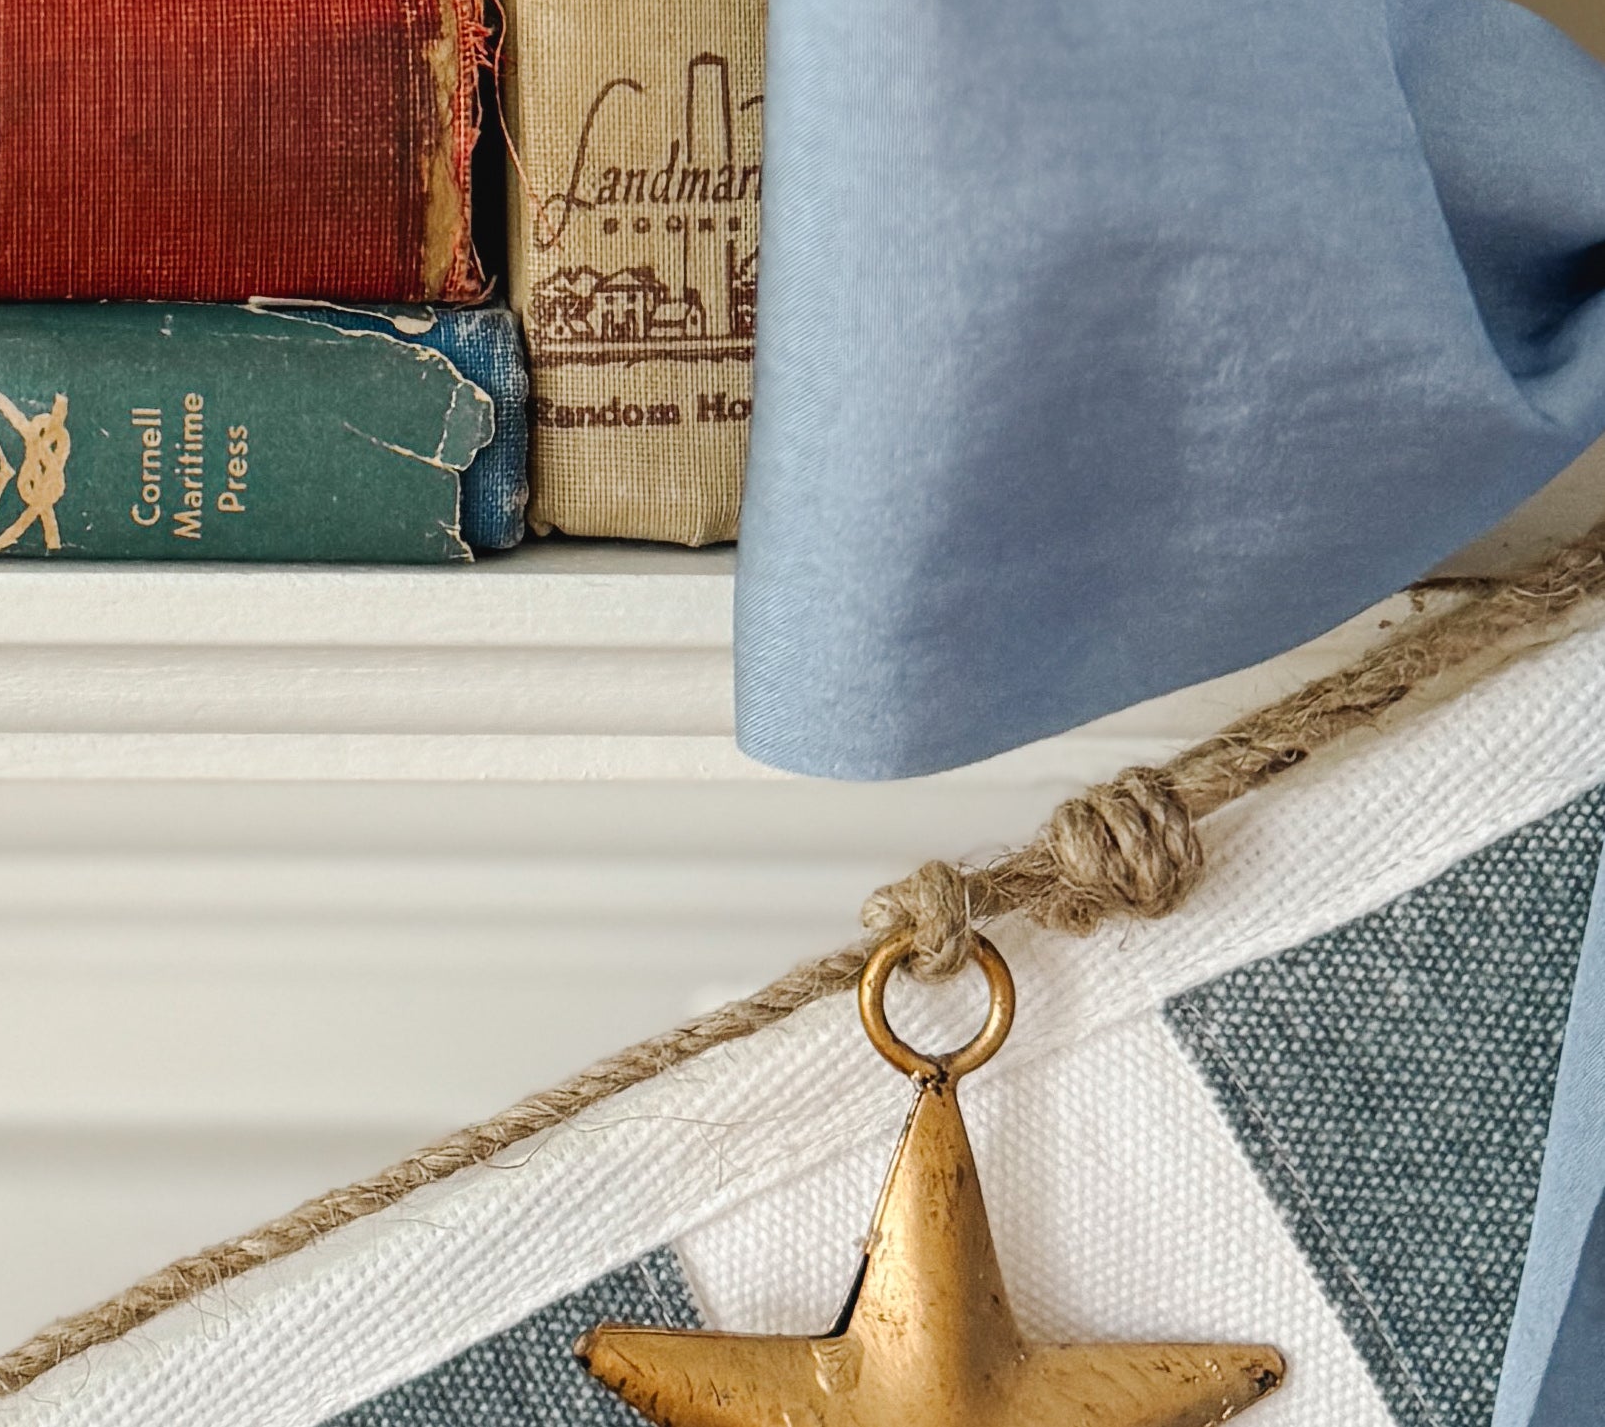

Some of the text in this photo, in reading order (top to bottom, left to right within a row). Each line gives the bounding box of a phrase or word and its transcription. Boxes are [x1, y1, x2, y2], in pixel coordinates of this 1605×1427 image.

[532, 78, 761, 253] Landmar
[173, 392, 204, 539] Maritime
[697, 392, 752, 422] Ho
[131, 408, 162, 527] Cornell
[217, 425, 248, 513] Press
